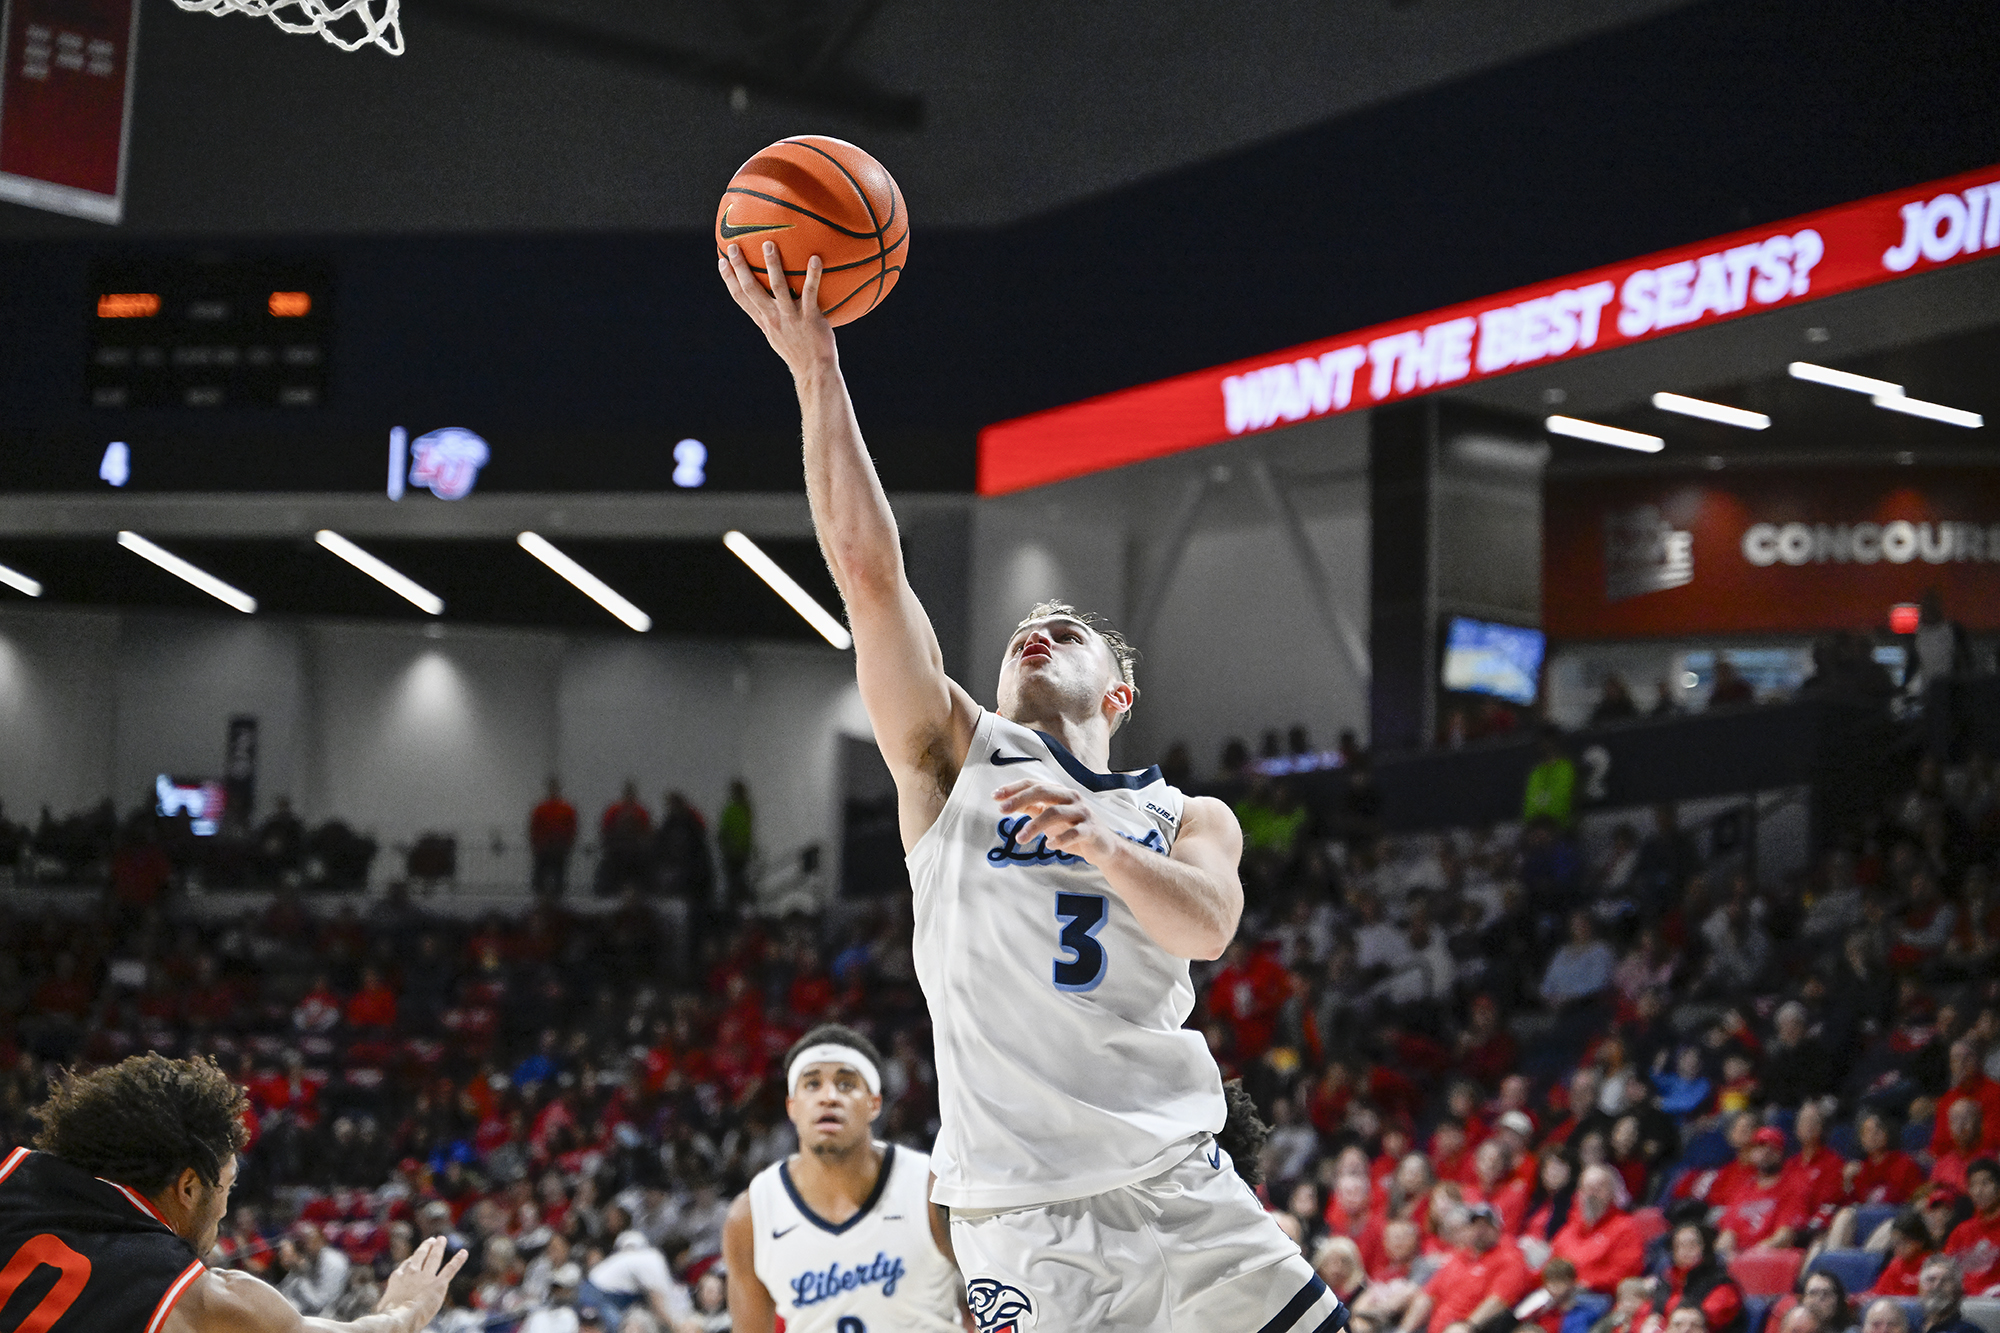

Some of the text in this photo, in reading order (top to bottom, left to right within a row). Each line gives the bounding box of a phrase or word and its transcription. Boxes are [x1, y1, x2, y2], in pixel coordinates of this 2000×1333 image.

[1222, 344, 1366, 433] WANT
[1369, 317, 1476, 399] THE
[1477, 283, 1613, 372] BEST
[1617, 229, 1824, 337] SEATS?
[1052, 891, 1109, 993] 3
[790, 1251, 906, 1308] Liberty
